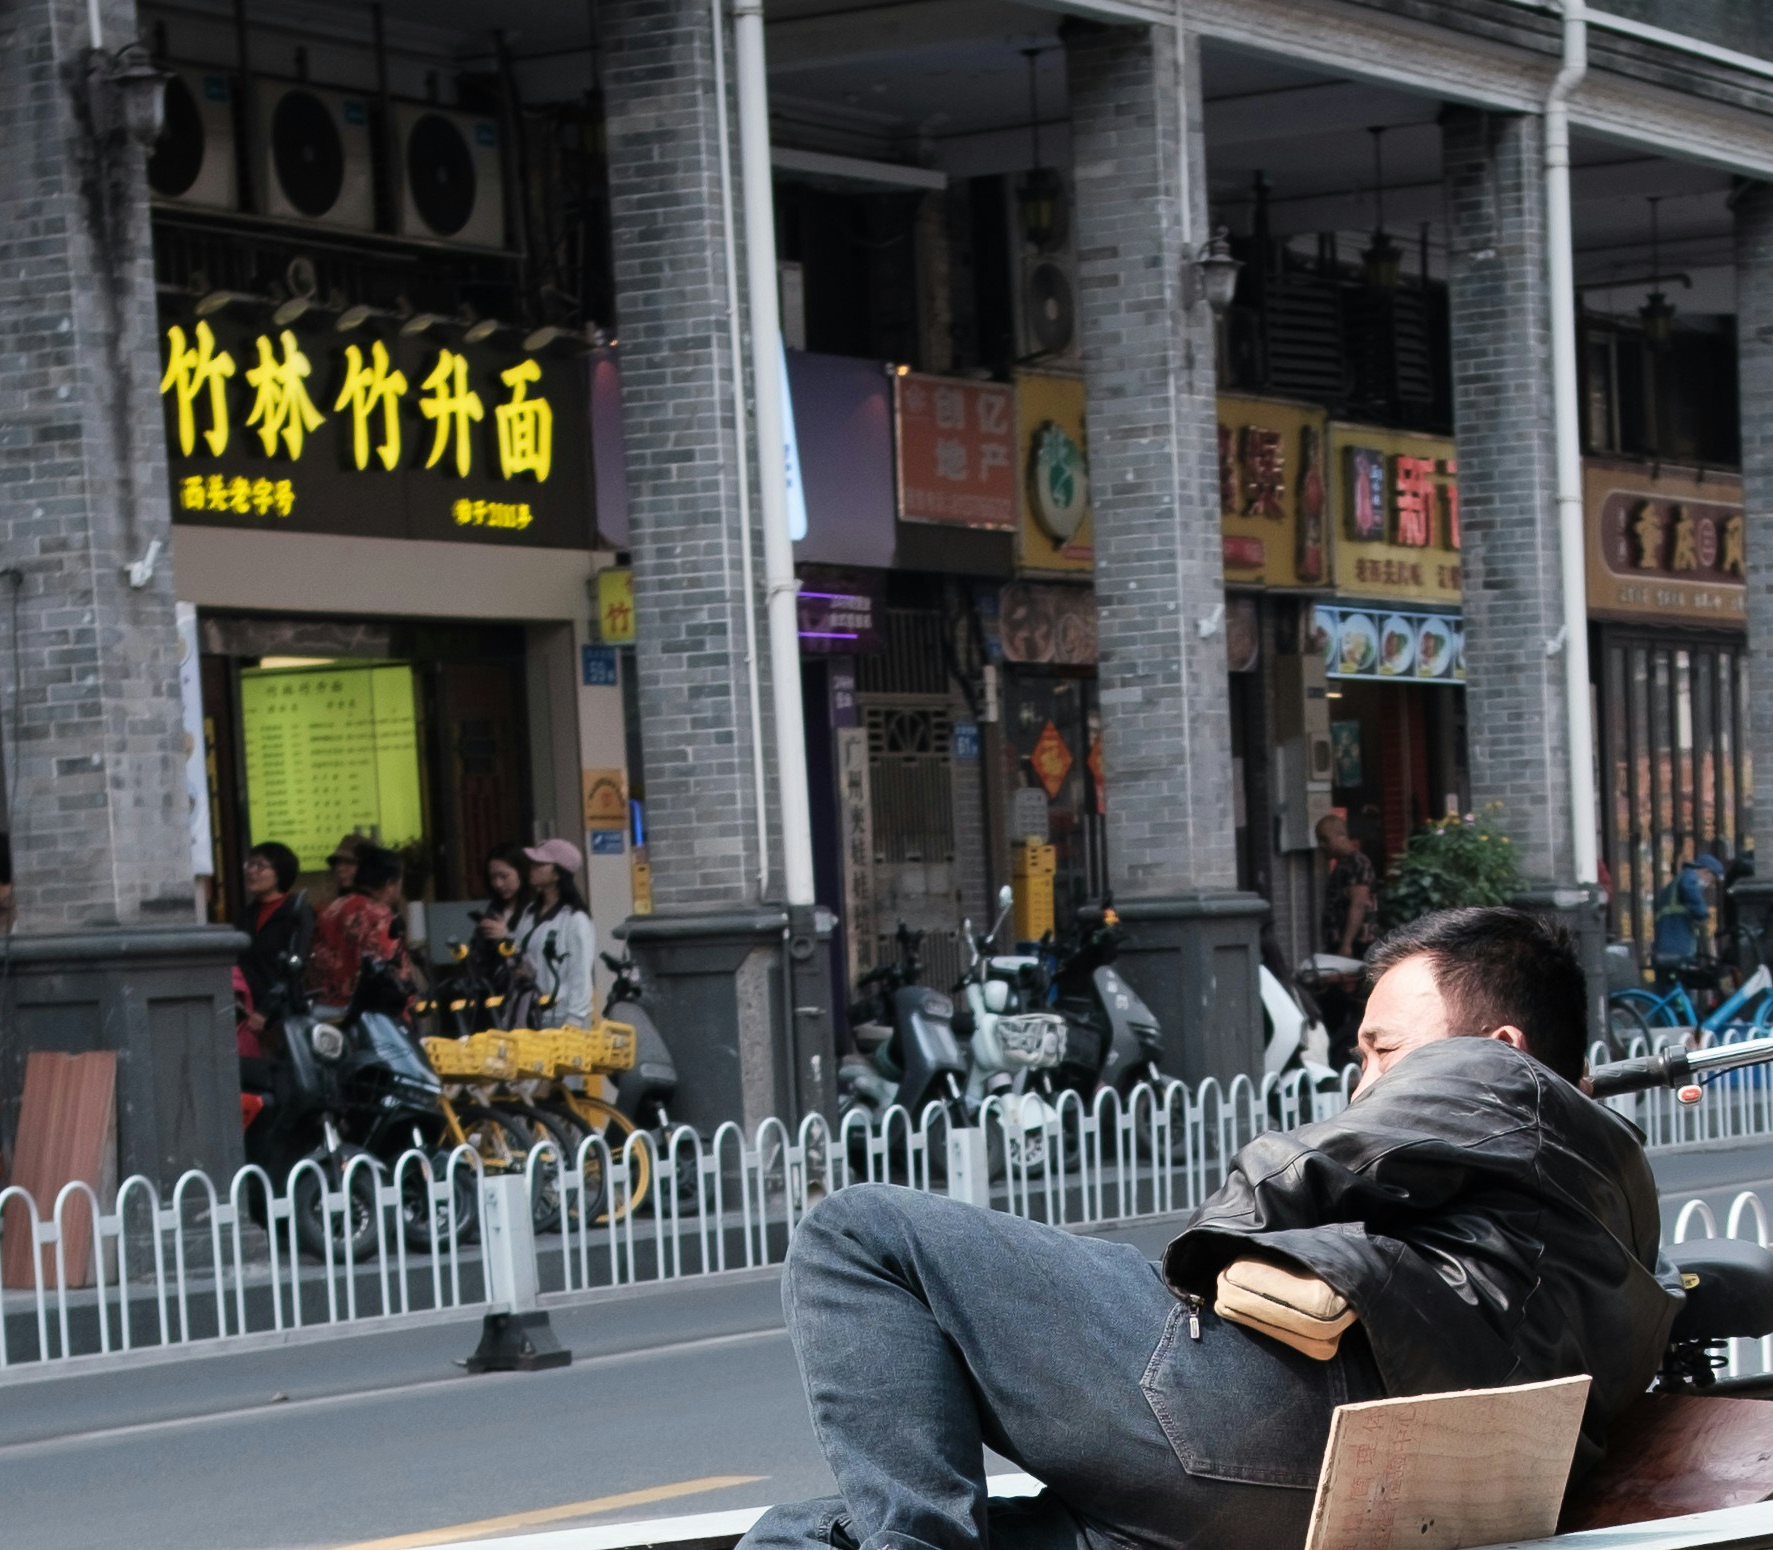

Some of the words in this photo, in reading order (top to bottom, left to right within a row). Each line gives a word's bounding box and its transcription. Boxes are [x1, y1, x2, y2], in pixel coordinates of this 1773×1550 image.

[159, 319, 553, 483] 竹林竹升面
